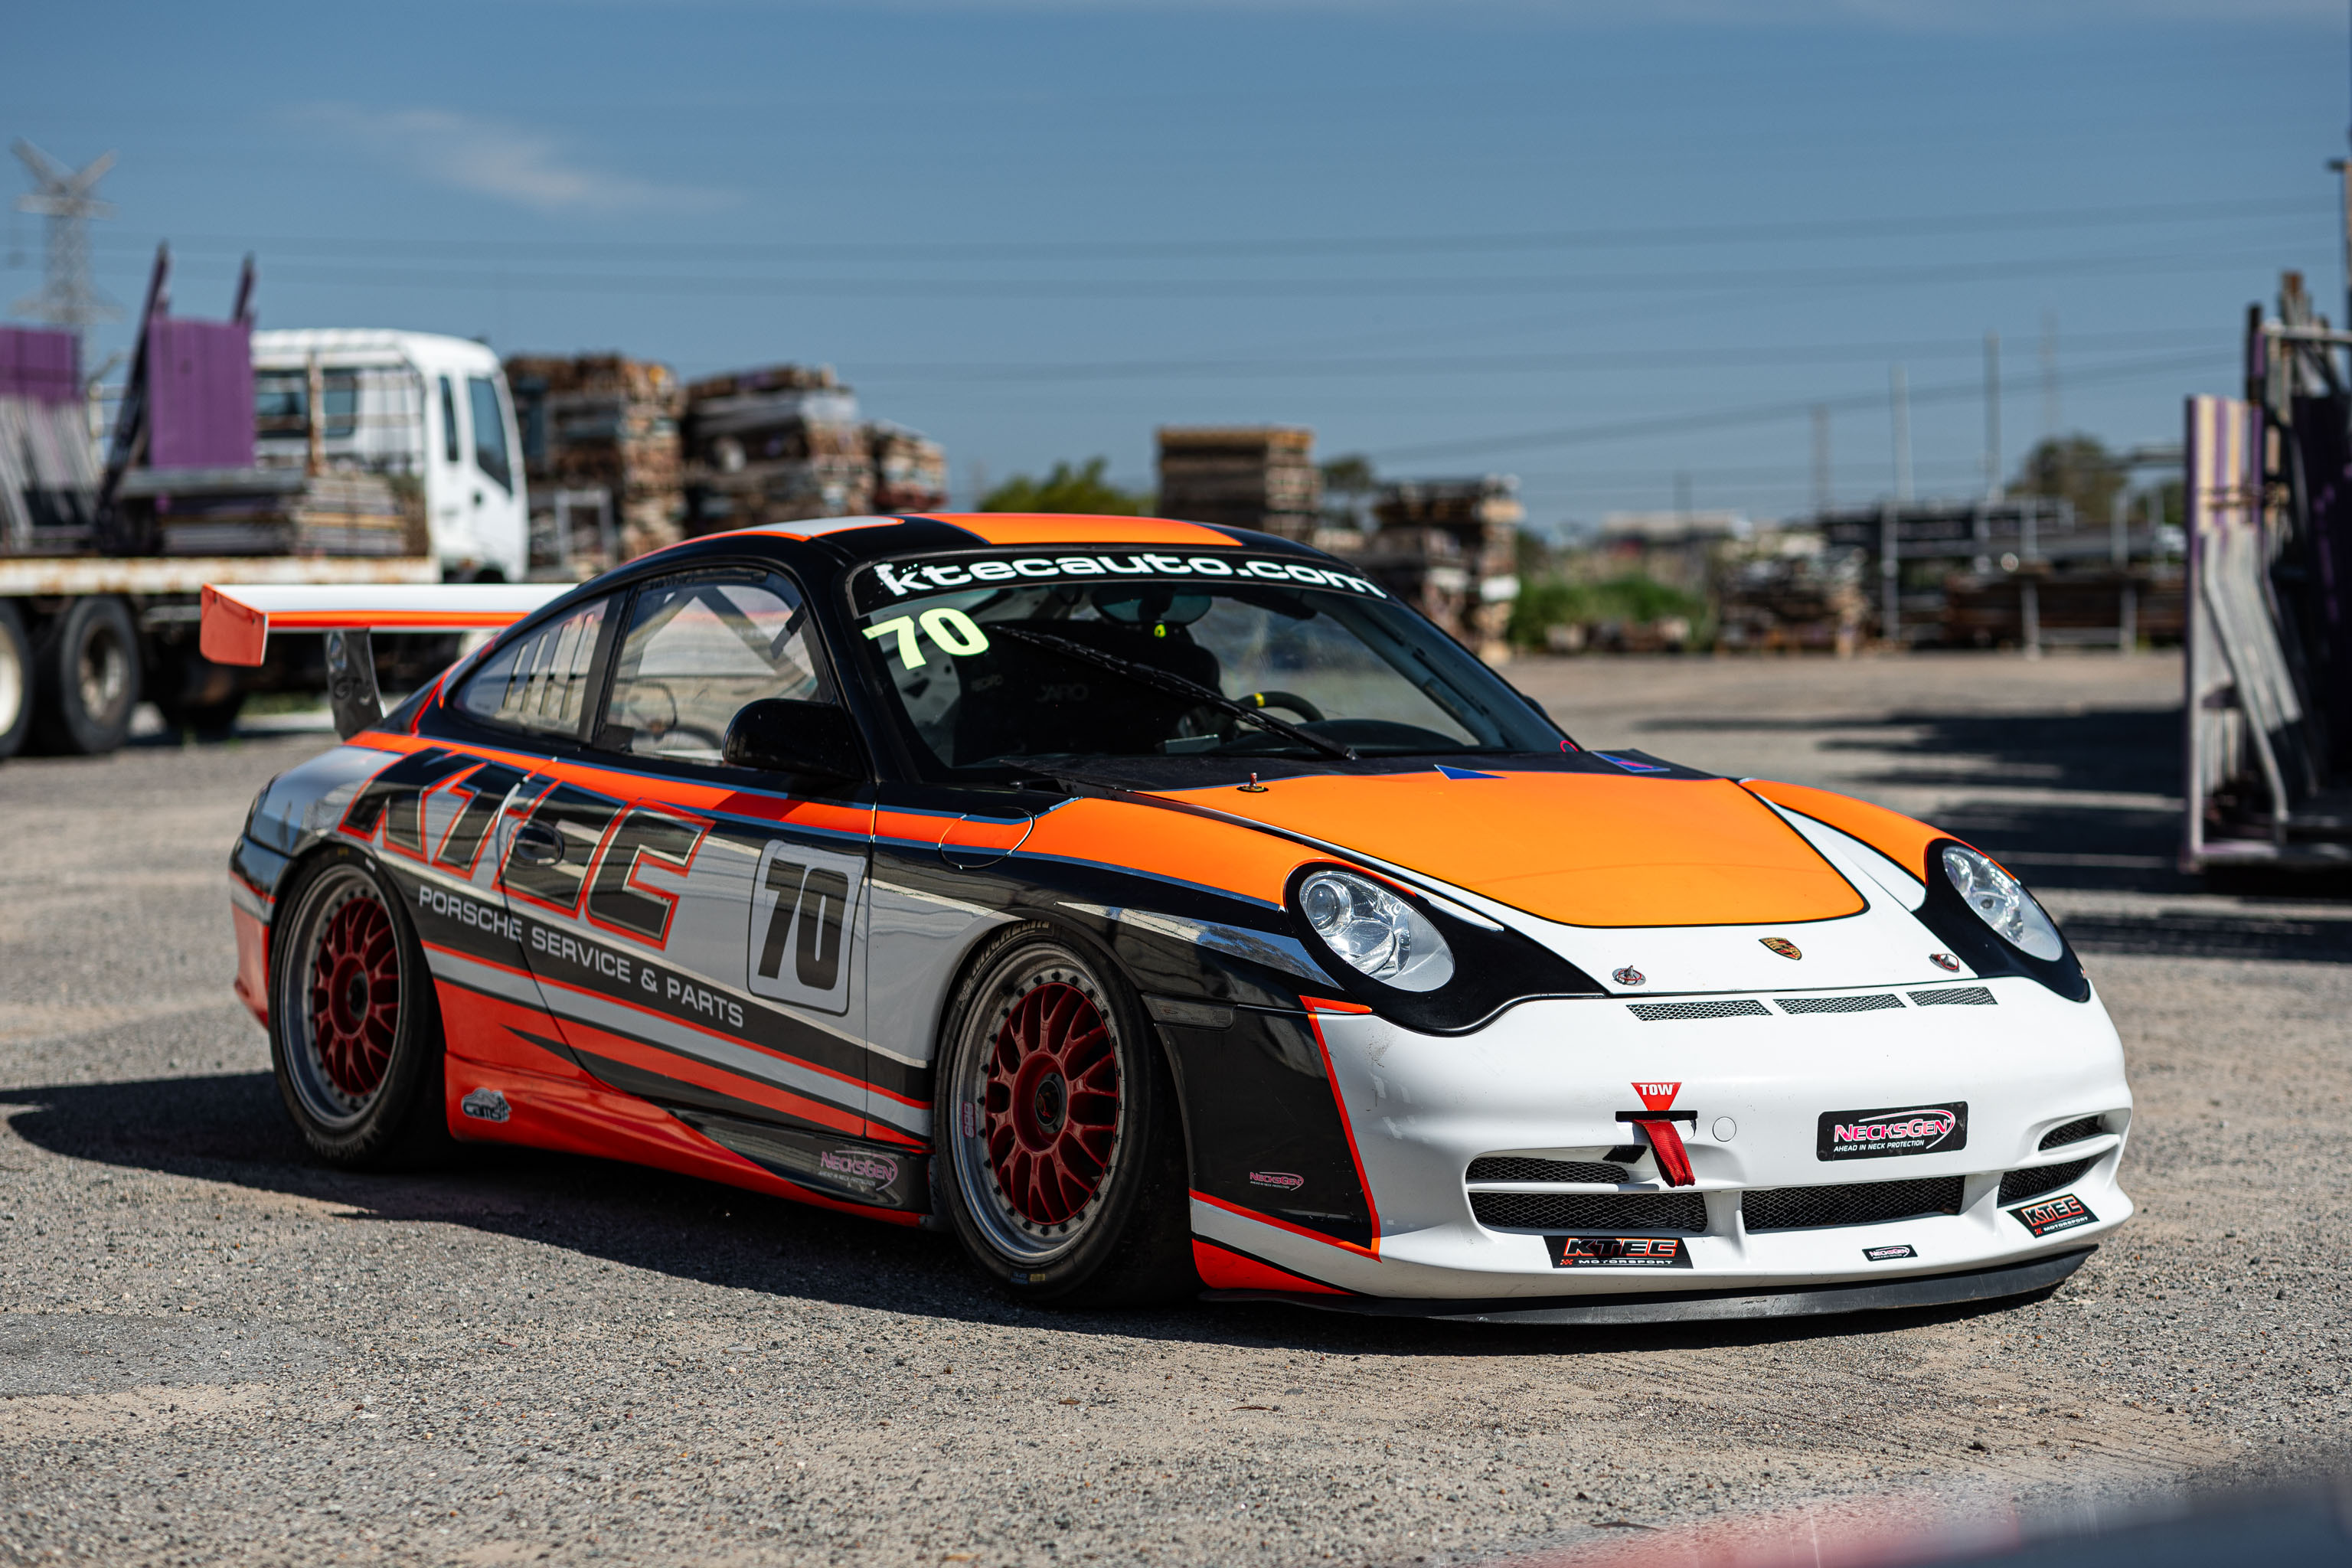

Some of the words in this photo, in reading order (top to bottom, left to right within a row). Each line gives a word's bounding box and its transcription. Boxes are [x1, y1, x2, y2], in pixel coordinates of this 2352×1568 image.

[874, 553, 1387, 599] ktecauto.com
[861, 607, 990, 671] 70
[758, 858, 848, 991] 70
[419, 885, 522, 942] PORSCHE
[531, 926, 631, 983] SERVICE
[641, 968, 658, 993] &
[667, 976, 743, 1027] PARTS
[1639, 1083, 1674, 1096] TOW
[1834, 1144, 1858, 1152] AHEAD
[1886, 1140, 1925, 1149] PROTECTION
[2020, 1195, 2085, 1227] KTEC
[2043, 1216, 2089, 1232] MOTORSPORT
[1563, 1237, 1679, 1257] KTEC
